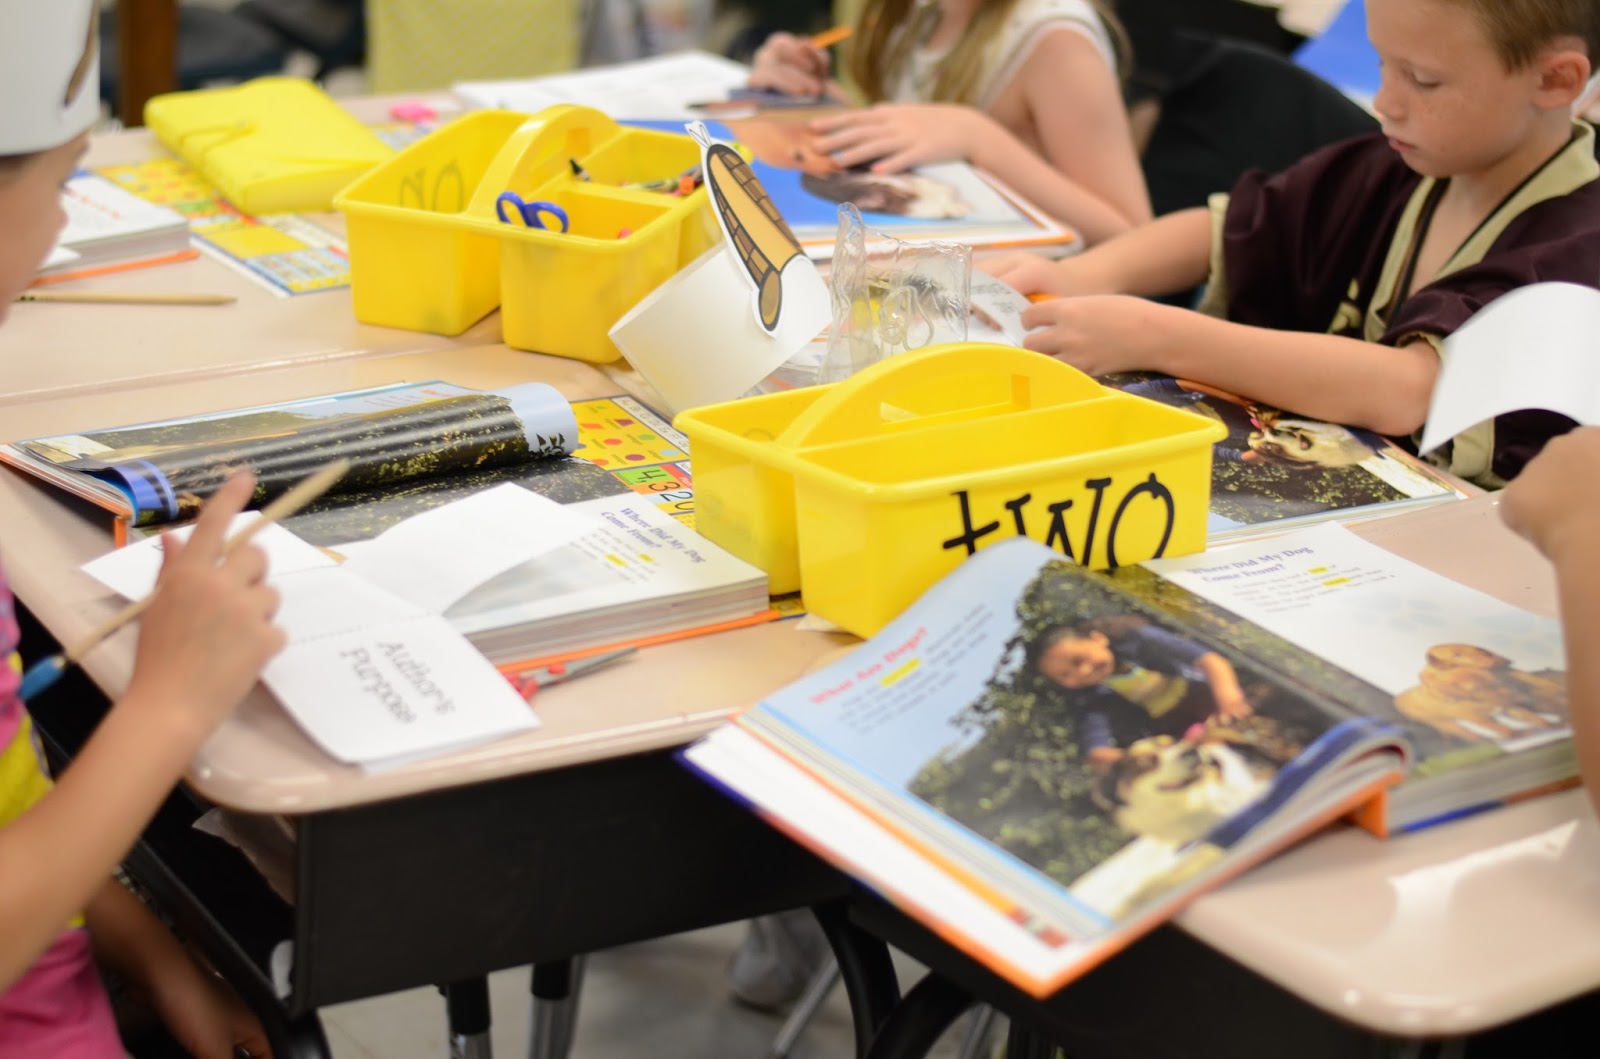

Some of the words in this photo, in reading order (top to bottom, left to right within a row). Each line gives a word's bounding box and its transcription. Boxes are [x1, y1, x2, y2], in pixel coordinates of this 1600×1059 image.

[942, 472, 1175, 573] two
[1231, 558, 1259, 569] Did
[1257, 553, 1284, 563] My
[1281, 547, 1315, 558] Dog
[1241, 563, 1285, 577] From?
[338, 647, 417, 724] Purpose
